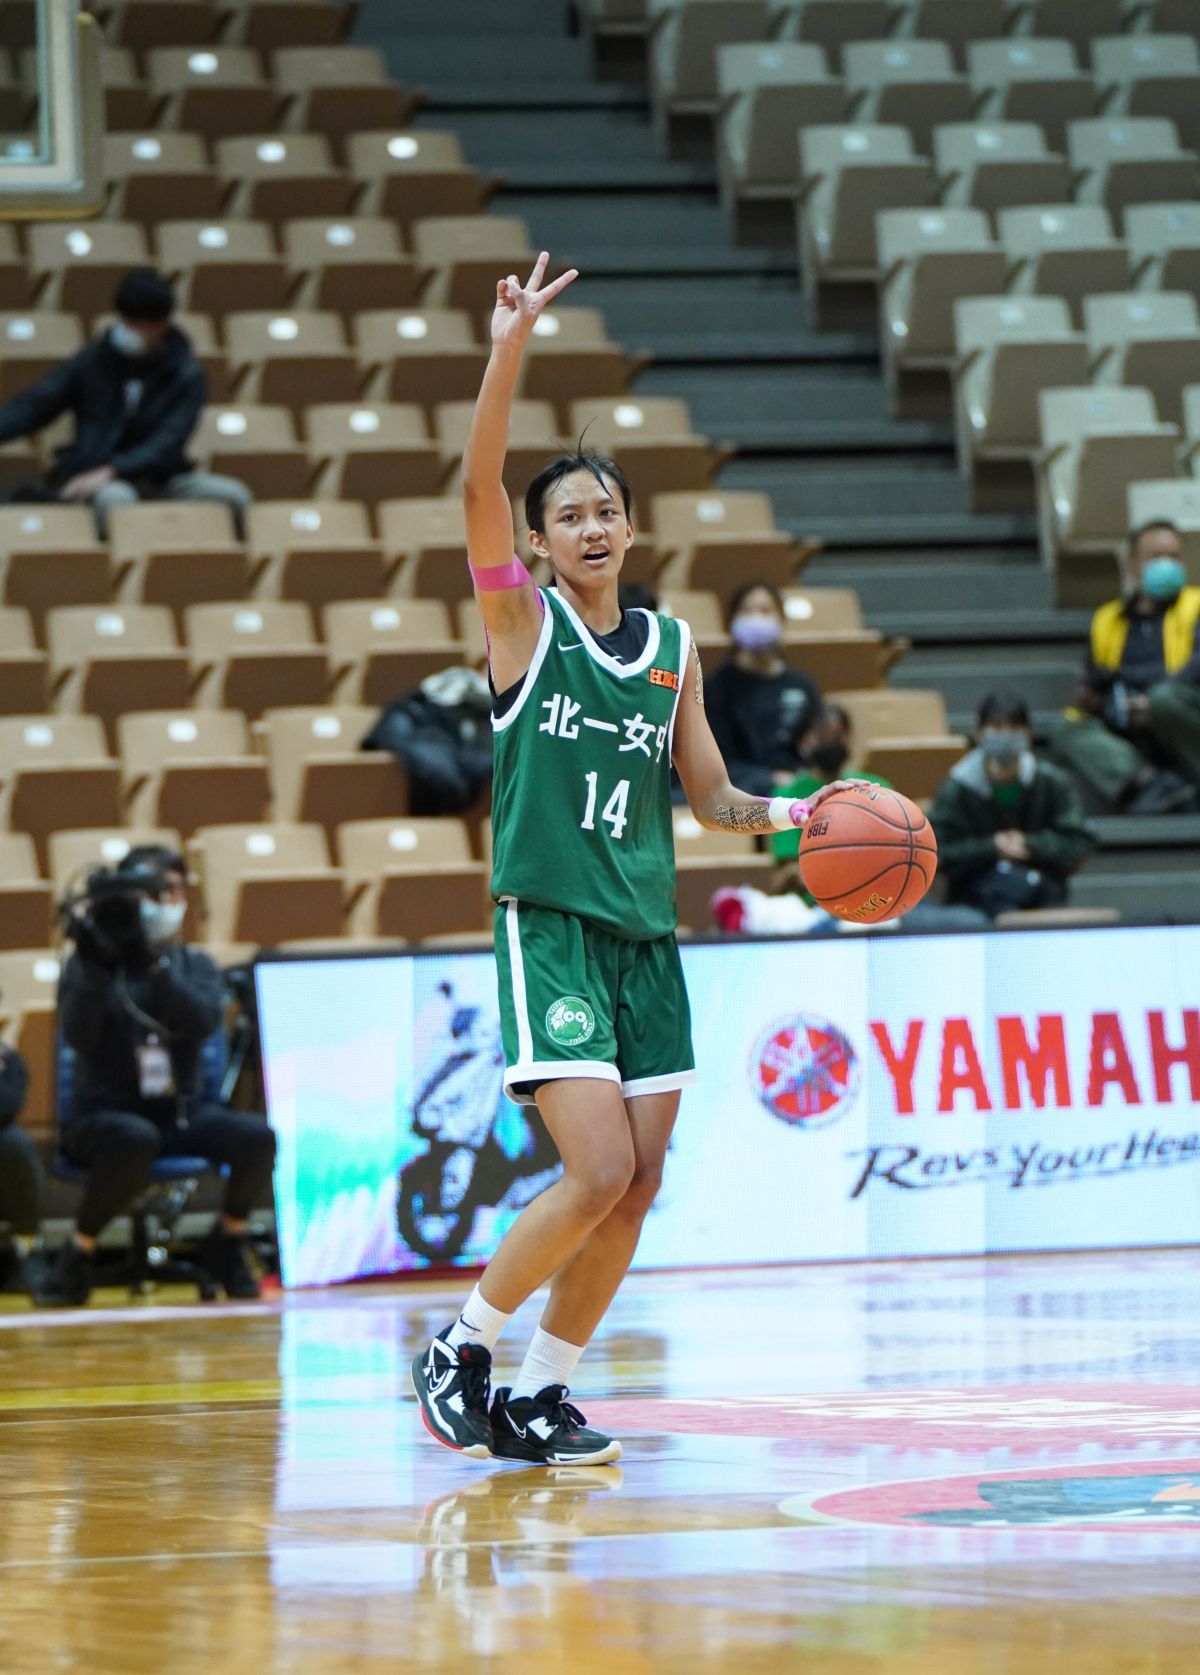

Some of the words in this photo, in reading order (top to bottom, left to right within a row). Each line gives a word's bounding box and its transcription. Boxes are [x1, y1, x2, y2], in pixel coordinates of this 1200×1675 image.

[580, 770, 631, 840] 14
[807, 821, 830, 839] FIBA
[868, 1006, 1200, 1114] YAMAH
